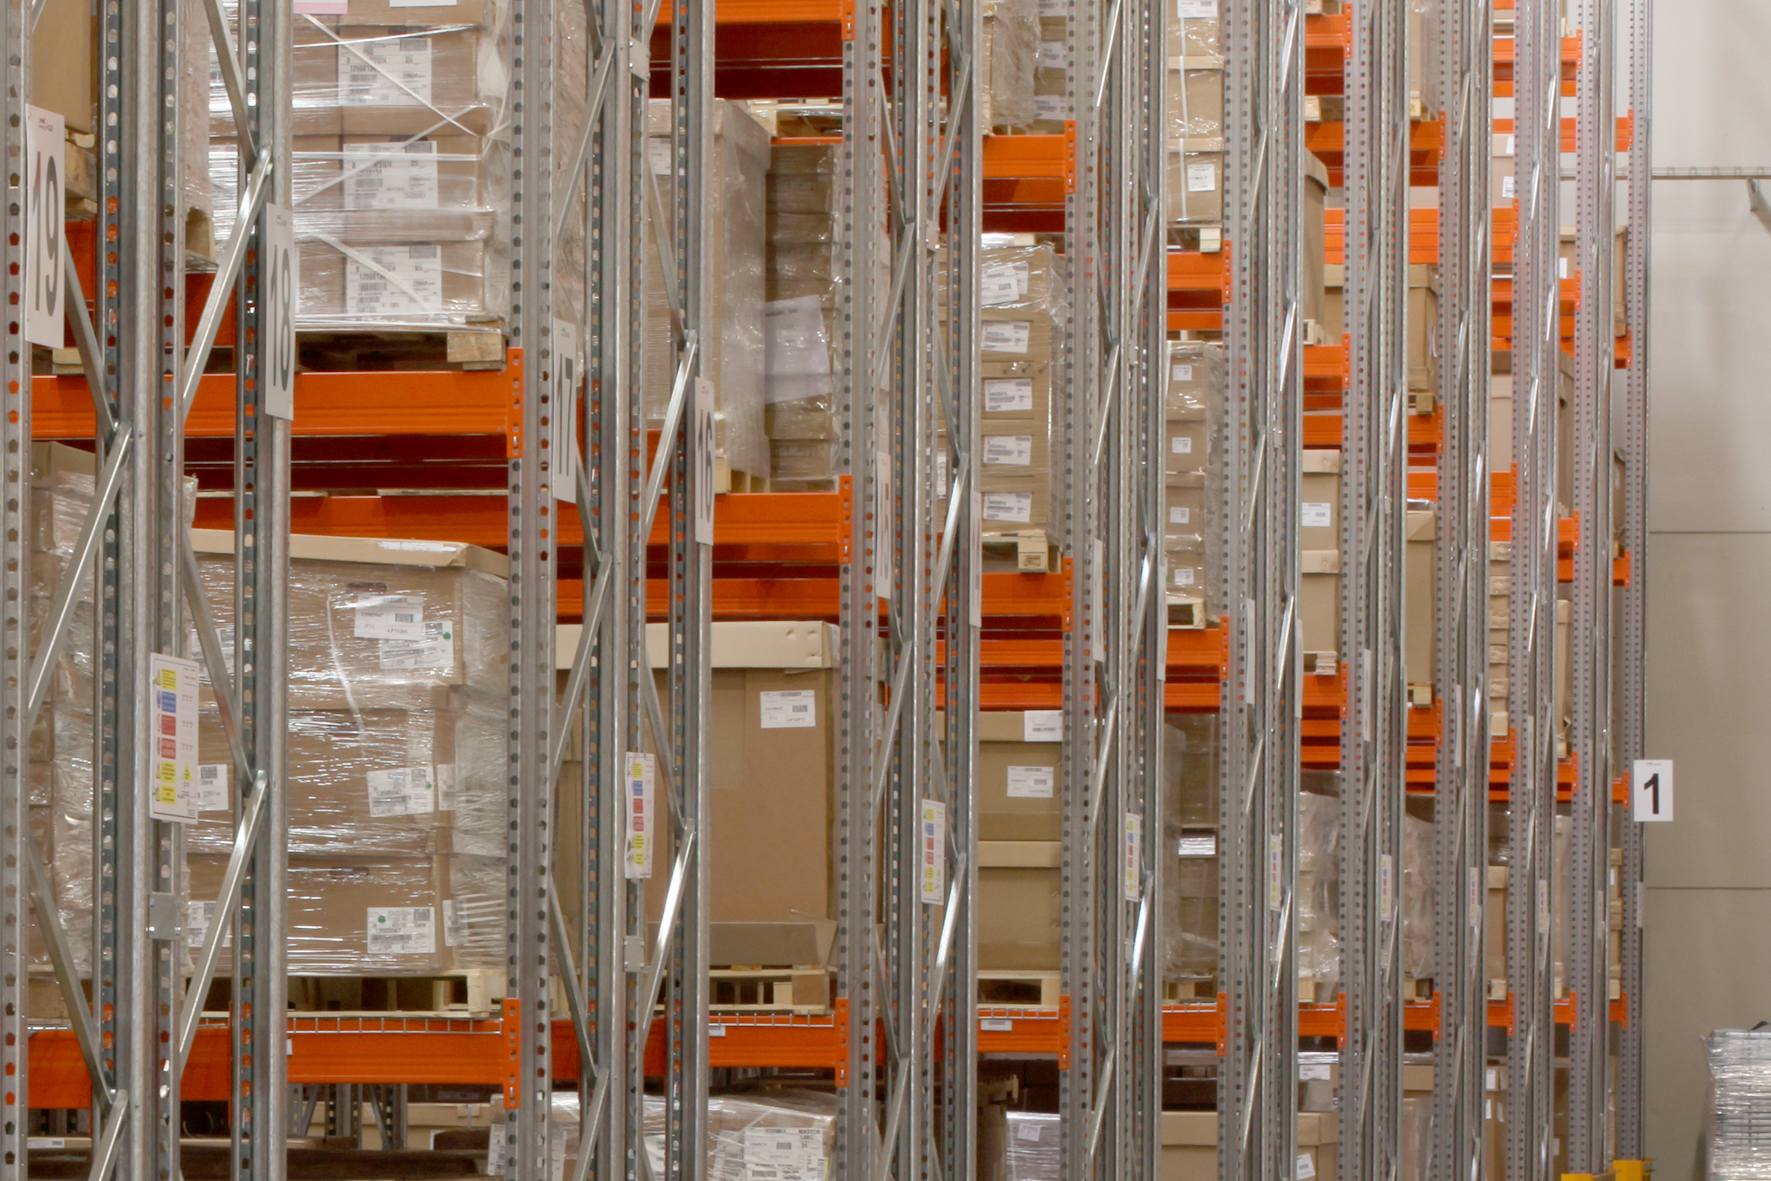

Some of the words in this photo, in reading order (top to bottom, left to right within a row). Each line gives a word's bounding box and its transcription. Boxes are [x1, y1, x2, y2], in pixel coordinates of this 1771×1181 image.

[32, 151, 59, 317] 19
[270, 244, 291, 392] 18
[556, 353, 574, 477] 17
[698, 408, 713, 523] 16
[1643, 772, 1660, 815] 1
